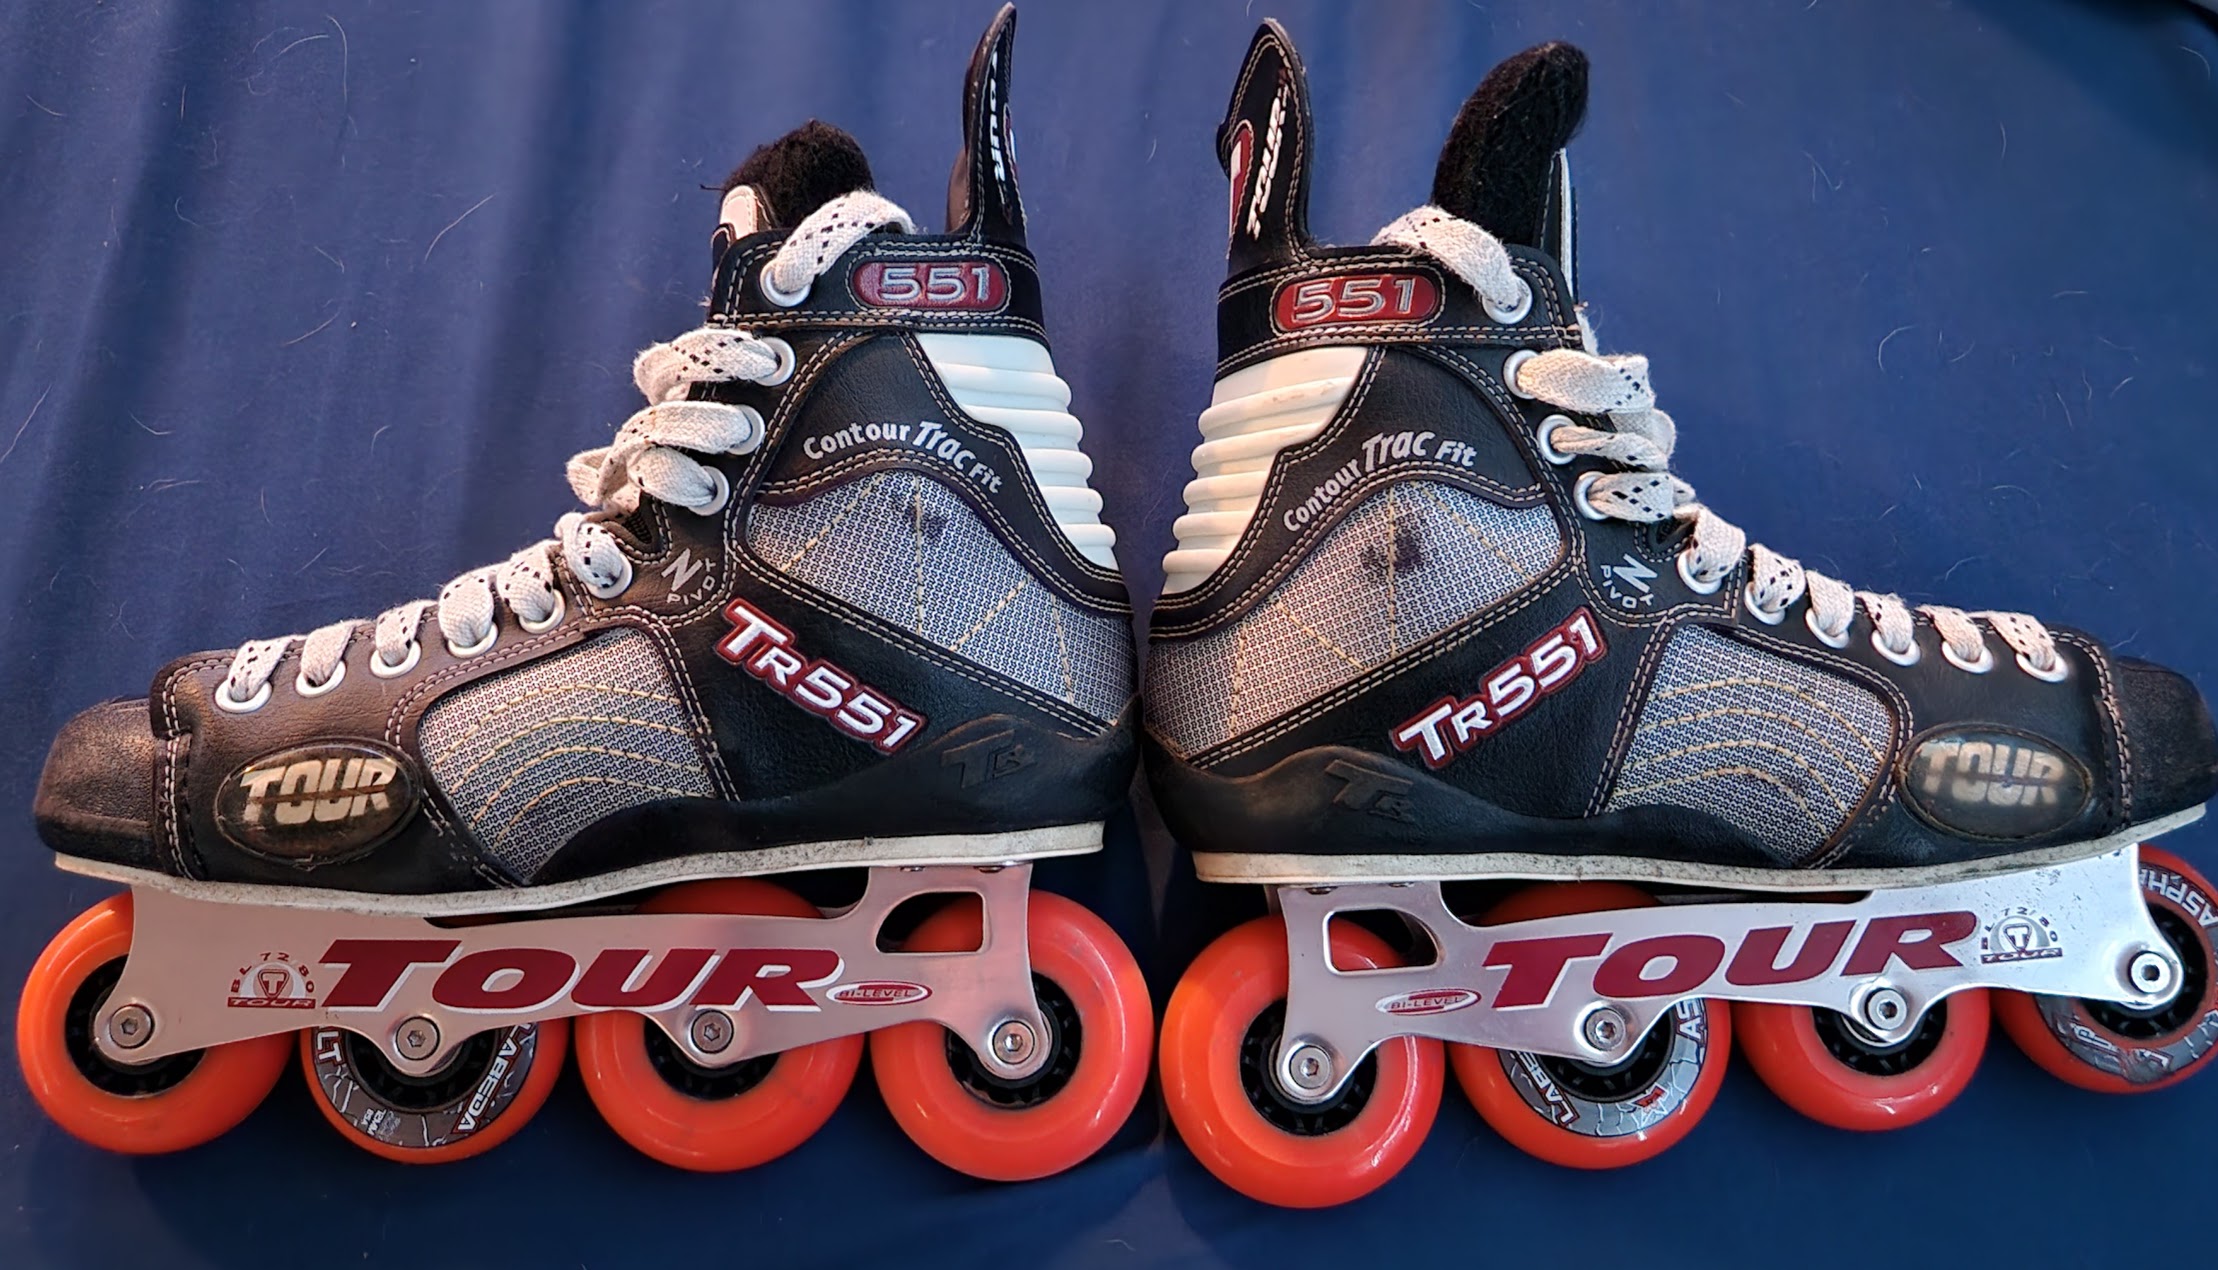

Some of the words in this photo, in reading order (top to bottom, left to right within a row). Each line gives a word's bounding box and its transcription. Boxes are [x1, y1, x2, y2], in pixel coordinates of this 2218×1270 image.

[878, 265, 990, 303] 551
[1291, 277, 1416, 324] 551
[803, 421, 911, 460] Contour
[968, 461, 1003, 495] Fit
[1283, 458, 1363, 532] Contour
[1434, 439, 1478, 468] Fit
[666, 557, 717, 606] PIVOT
[1600, 564, 1655, 609] PIVOT
[239, 757, 398, 825] TOUR
[1919, 740, 2065, 807] TOUR
[318, 938, 845, 1013] TOUR
[1481, 909, 1979, 1013] TOUR
[230, 997, 315, 1008] TOUR
[838, 988, 913, 998] BI-LEVEL
[1389, 996, 1463, 1010] BI-LEVEL
[316, 1027, 342, 1064] LT
[457, 1022, 532, 1131] LABEDA
[1515, 1050, 1579, 1125] LABE
